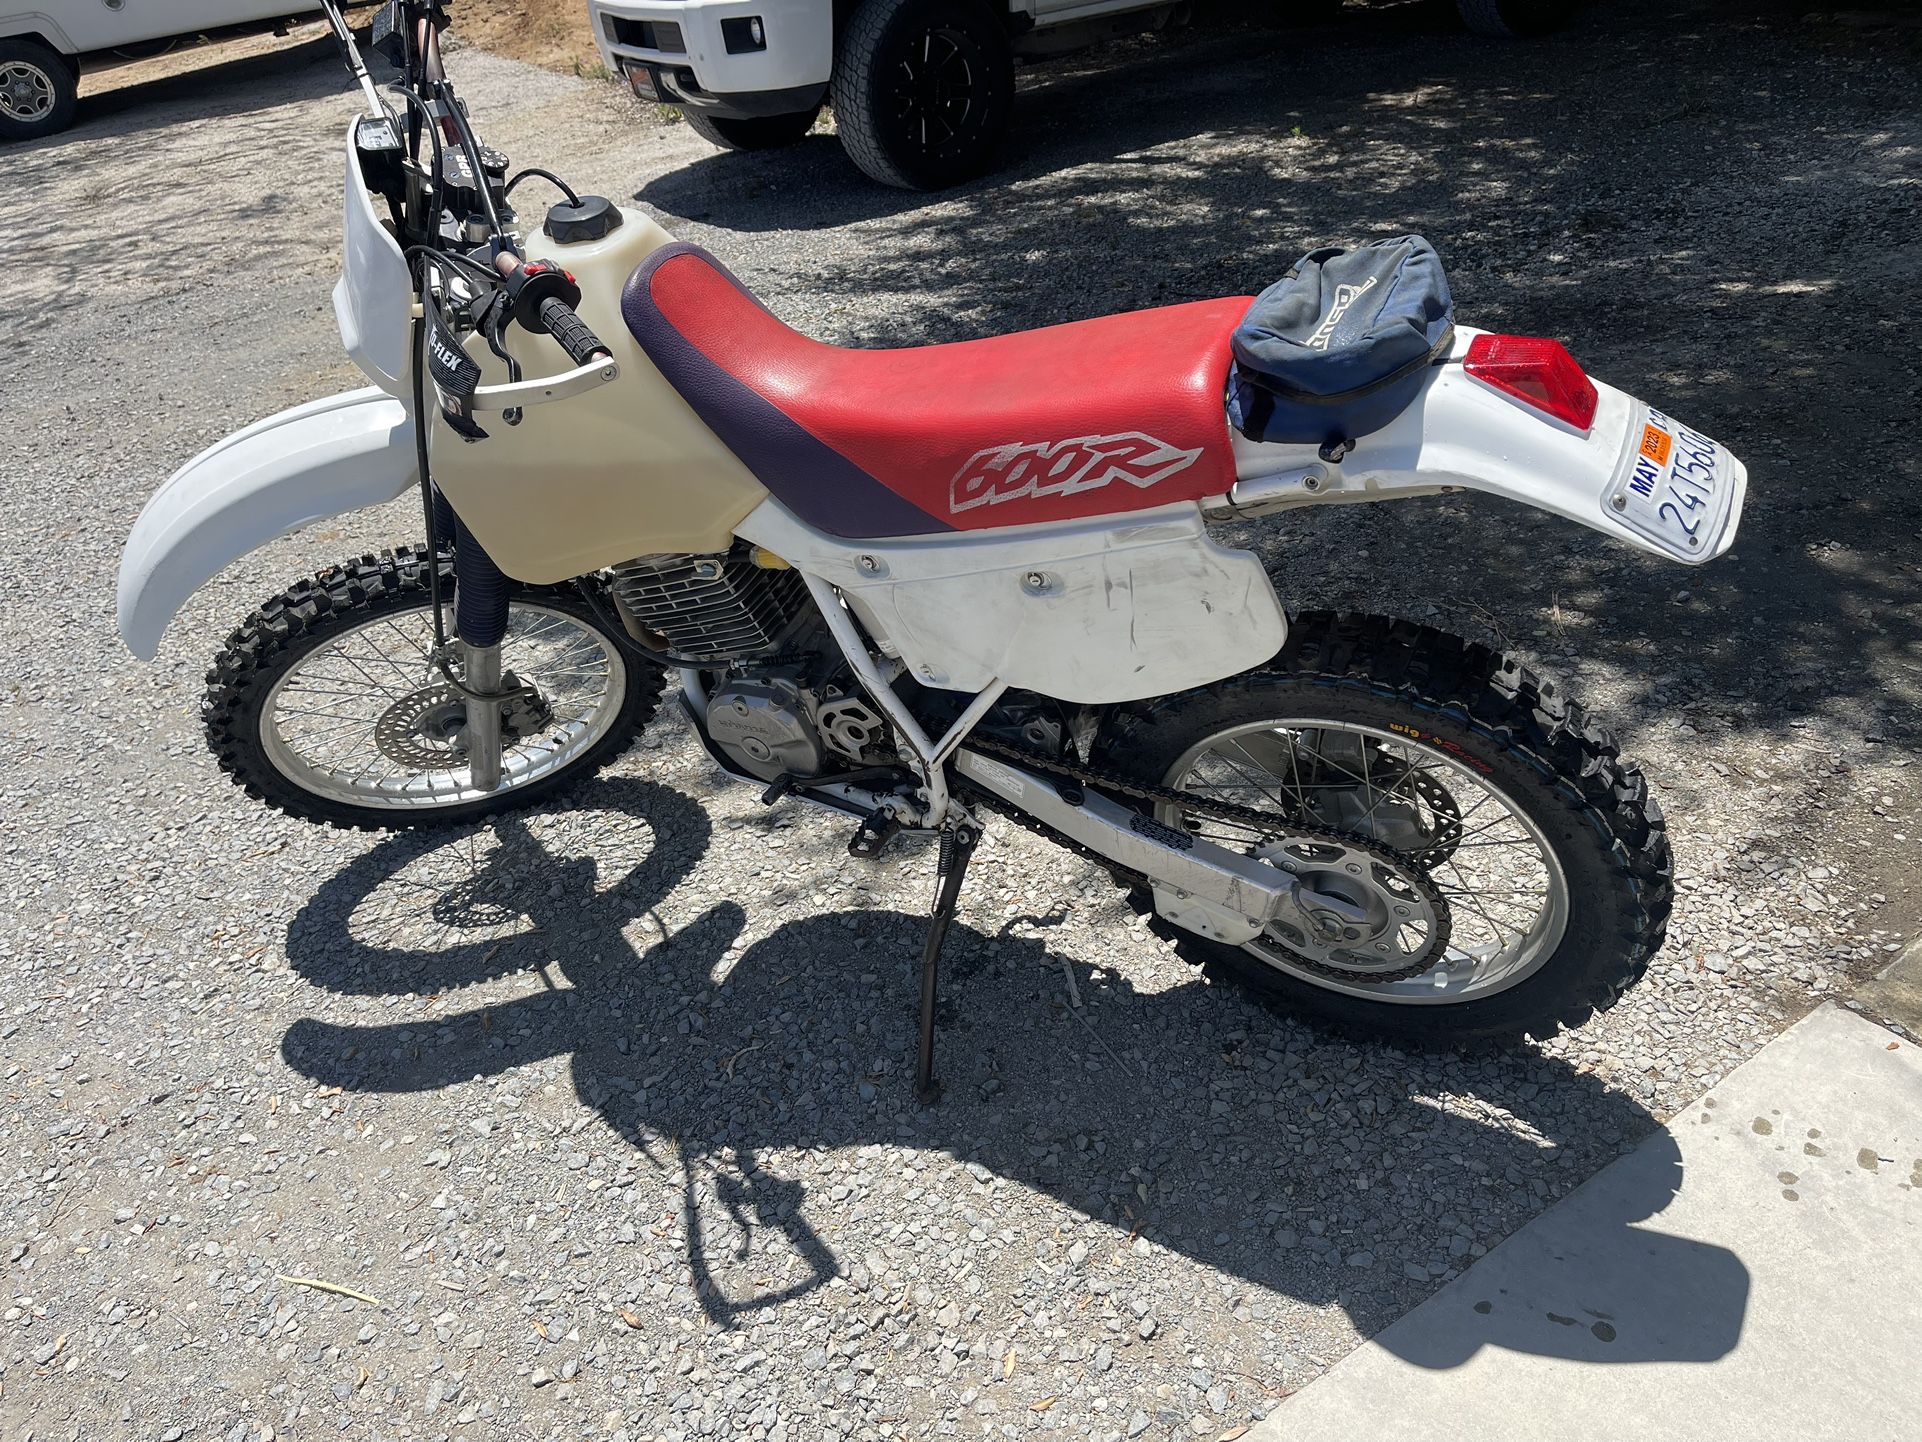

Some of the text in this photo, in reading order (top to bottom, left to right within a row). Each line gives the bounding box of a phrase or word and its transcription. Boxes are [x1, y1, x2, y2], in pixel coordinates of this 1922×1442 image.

[455, 154, 473, 178] GPR
[949, 431, 1205, 514] 600R
[1629, 456, 1659, 499] MAY
[1645, 431, 1660, 454] 2023
